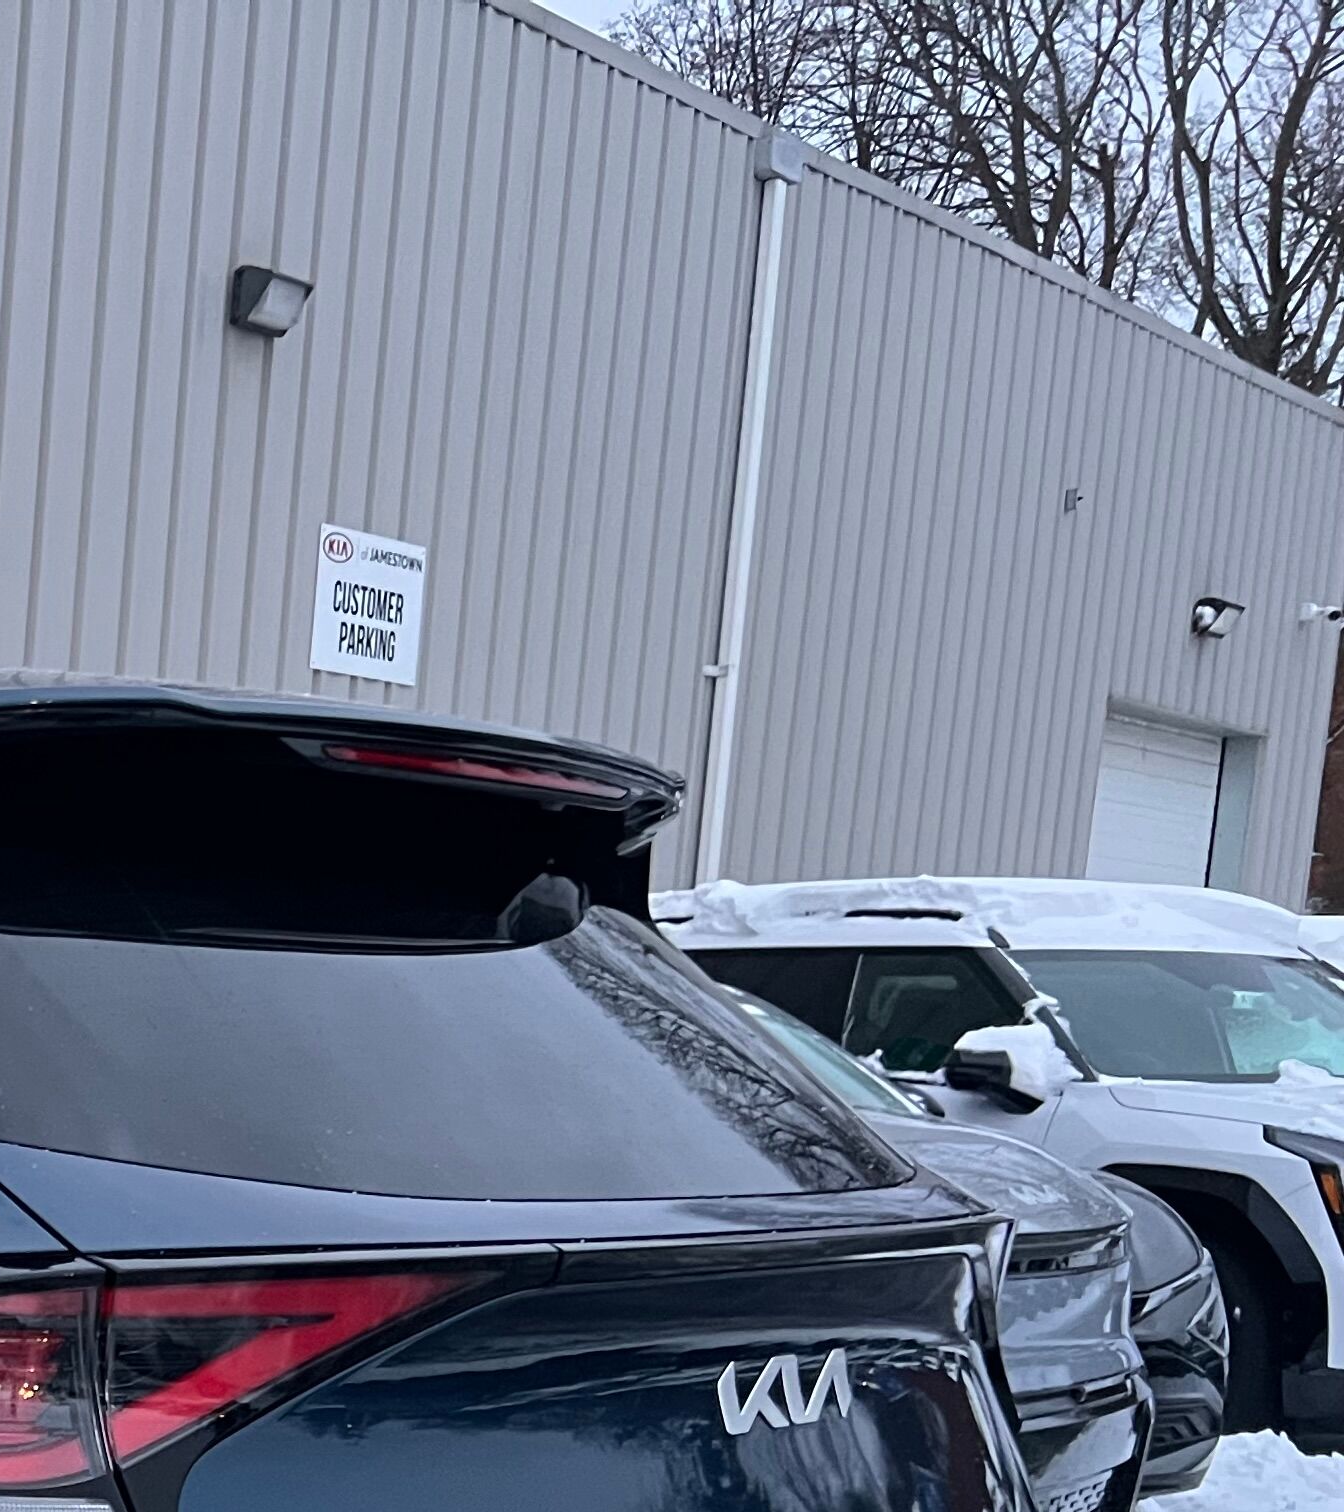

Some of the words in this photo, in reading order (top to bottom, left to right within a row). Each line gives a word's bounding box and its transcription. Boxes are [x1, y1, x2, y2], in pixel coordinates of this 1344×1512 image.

[327, 538, 349, 559] KIA
[370, 547, 423, 572] JAMESTOWN
[333, 580, 404, 625] CUSTOMER
[338, 621, 396, 662] PARKING
[717, 1348, 852, 1436] KIA
